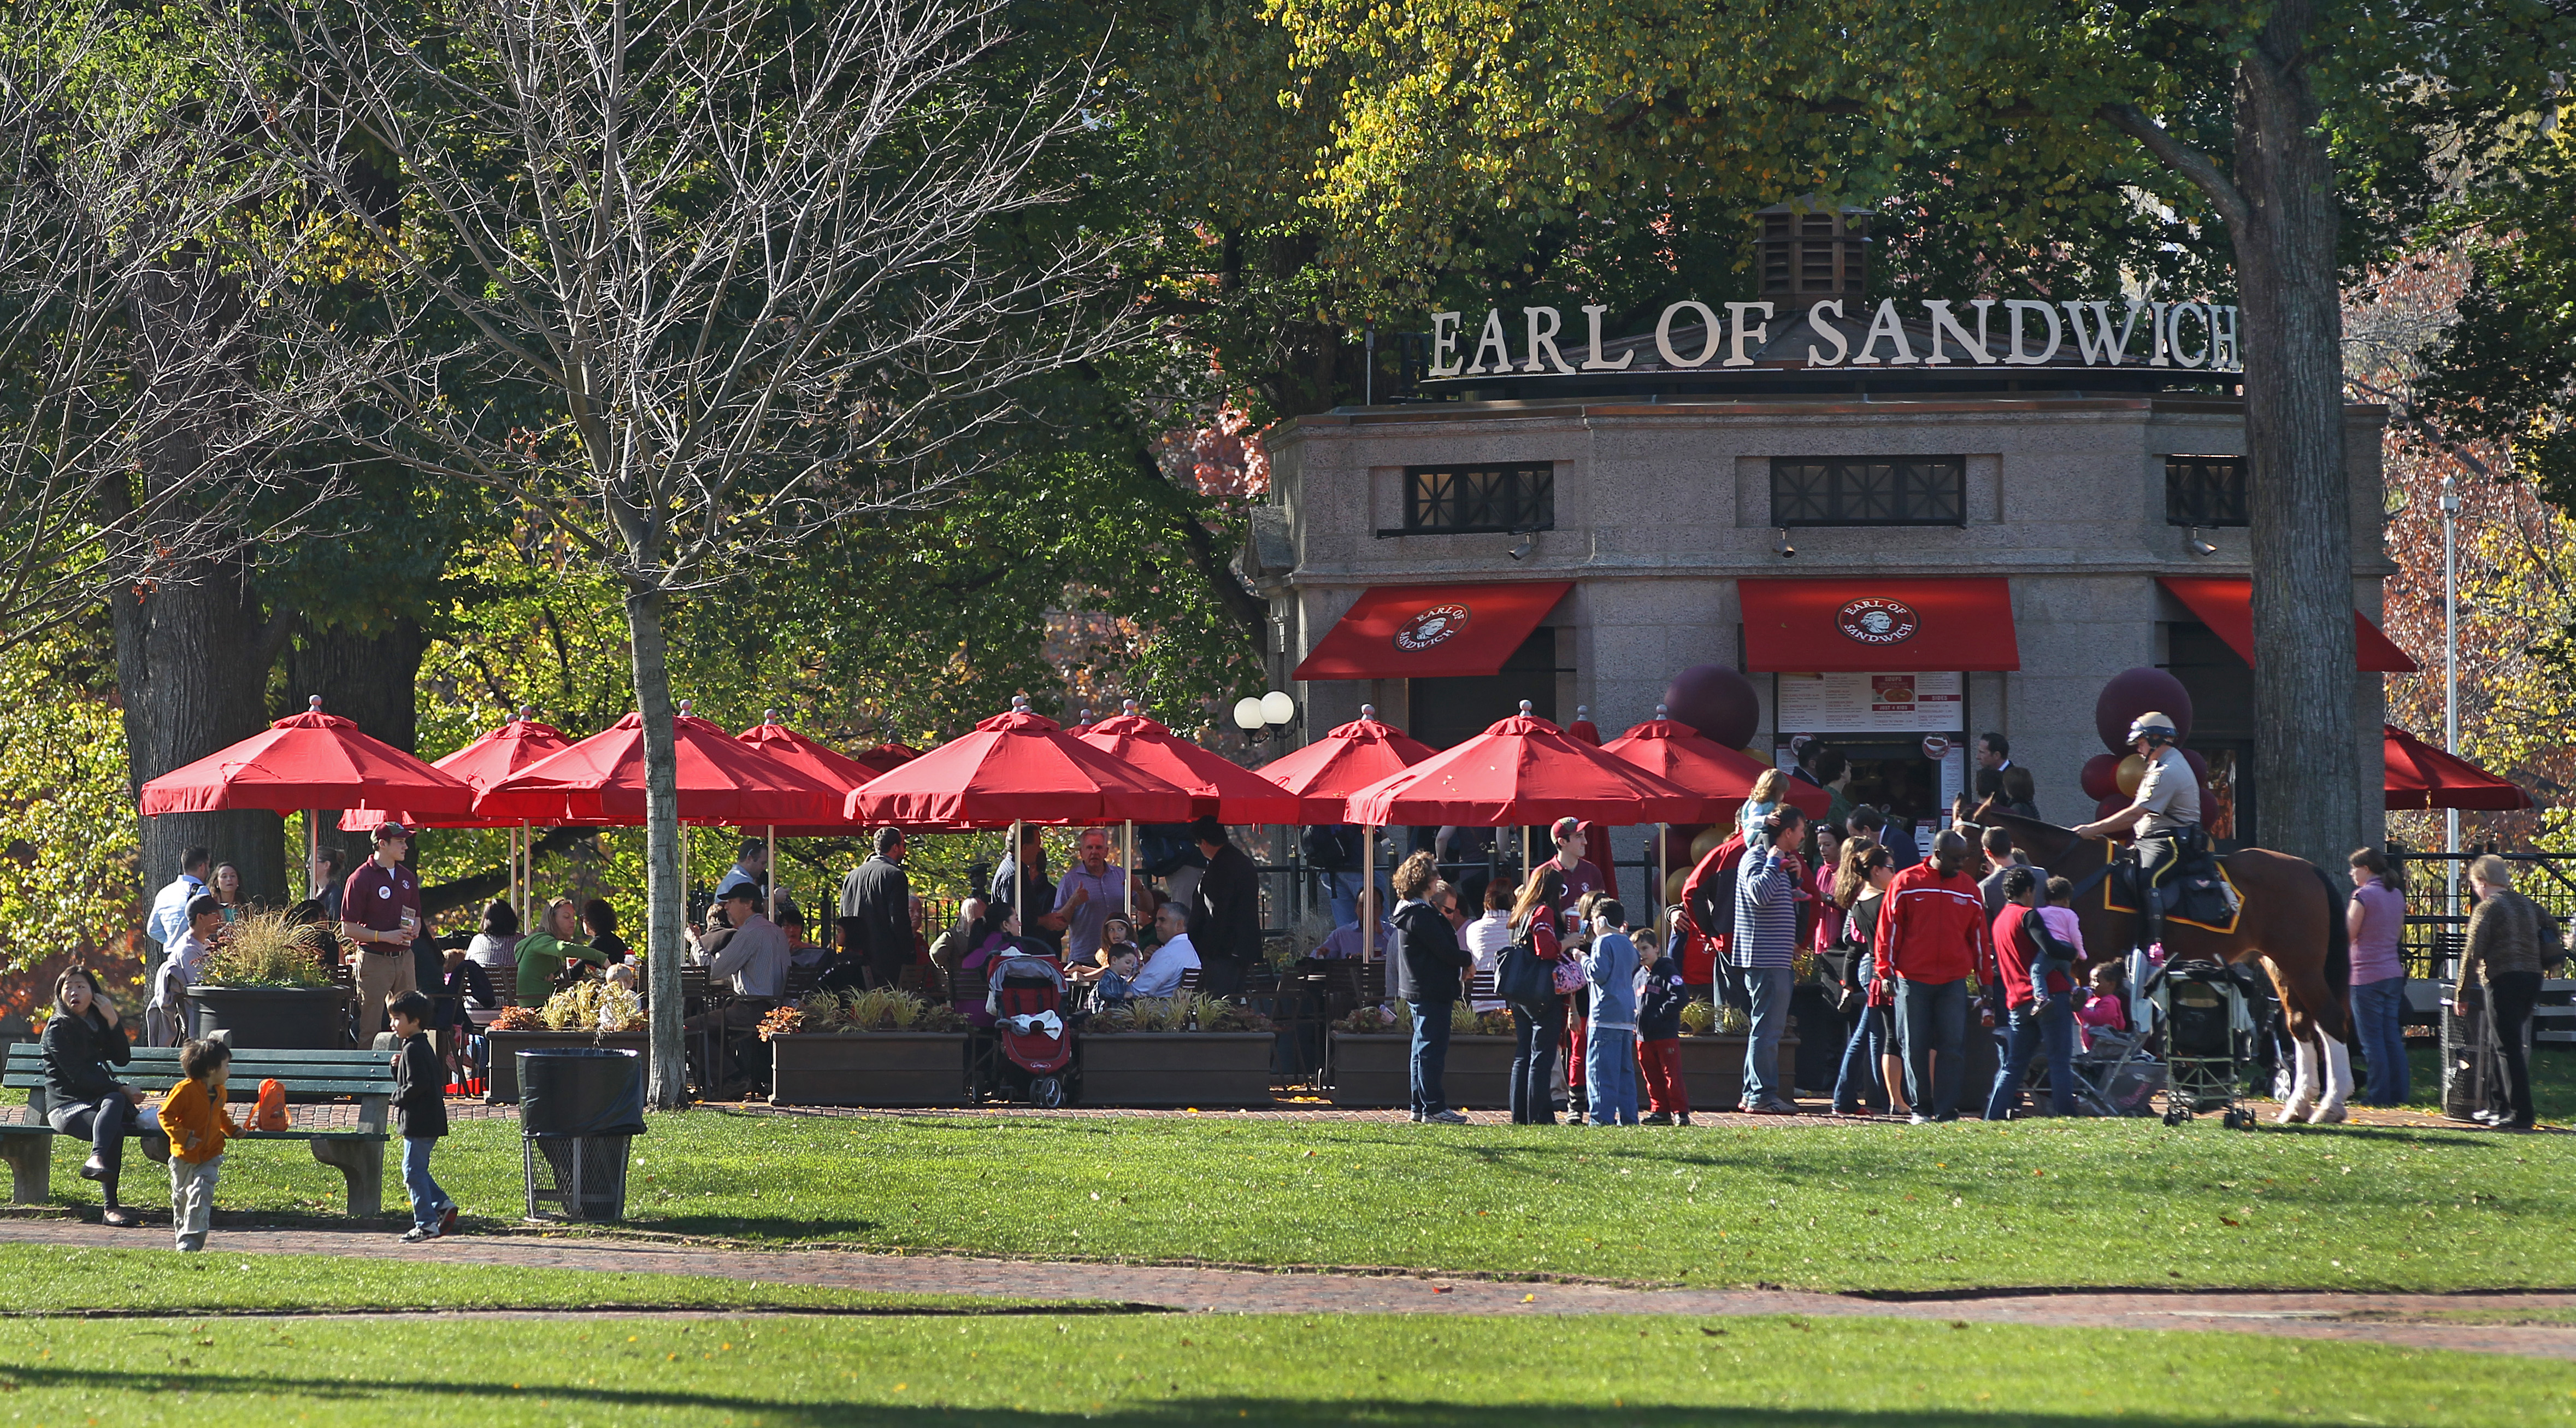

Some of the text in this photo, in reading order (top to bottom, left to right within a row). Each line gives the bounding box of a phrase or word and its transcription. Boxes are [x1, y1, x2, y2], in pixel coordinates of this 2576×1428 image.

[1428, 304, 1634, 377] EARL
[1655, 300, 1774, 368] OF
[1808, 298, 2240, 370] SANDWICH
[1416, 607, 1465, 622] EARL OF
[1844, 600, 1907, 615] EARL OF
[1399, 629, 1454, 649] SANDWICH
[1844, 623, 1913, 642] SANDWICH
